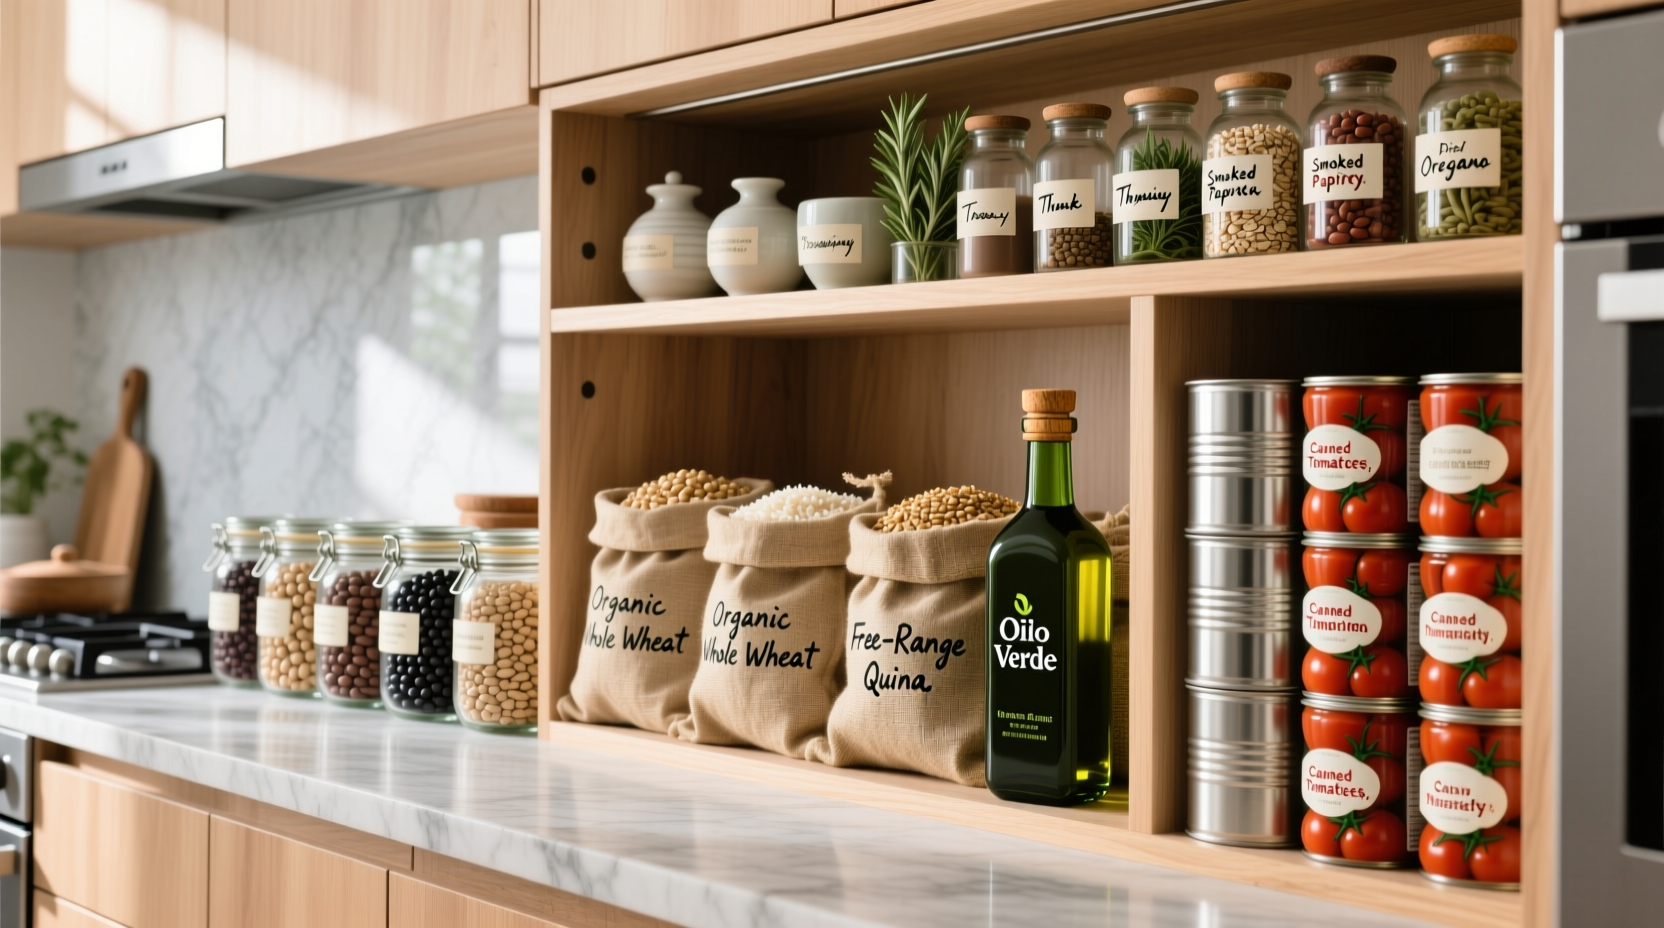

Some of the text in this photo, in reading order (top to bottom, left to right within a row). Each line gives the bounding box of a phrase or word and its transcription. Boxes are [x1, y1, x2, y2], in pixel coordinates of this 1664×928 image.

[1207, 164, 1257, 186] Smoked
[1311, 153, 1364, 172] Smoked
[1421, 154, 1492, 181] Oregano
[591, 585, 667, 623] Organic
[1309, 602, 1352, 617] Canned
[712, 601, 791, 640] Organic
[998, 616, 1051, 643] Oilo
[1430, 611, 1476, 626] Canned
[621, 625, 690, 654] Wheat
[850, 622, 967, 670] Free-Range
[745, 640, 821, 669] Wheat
[993, 644, 1058, 671] Verde
